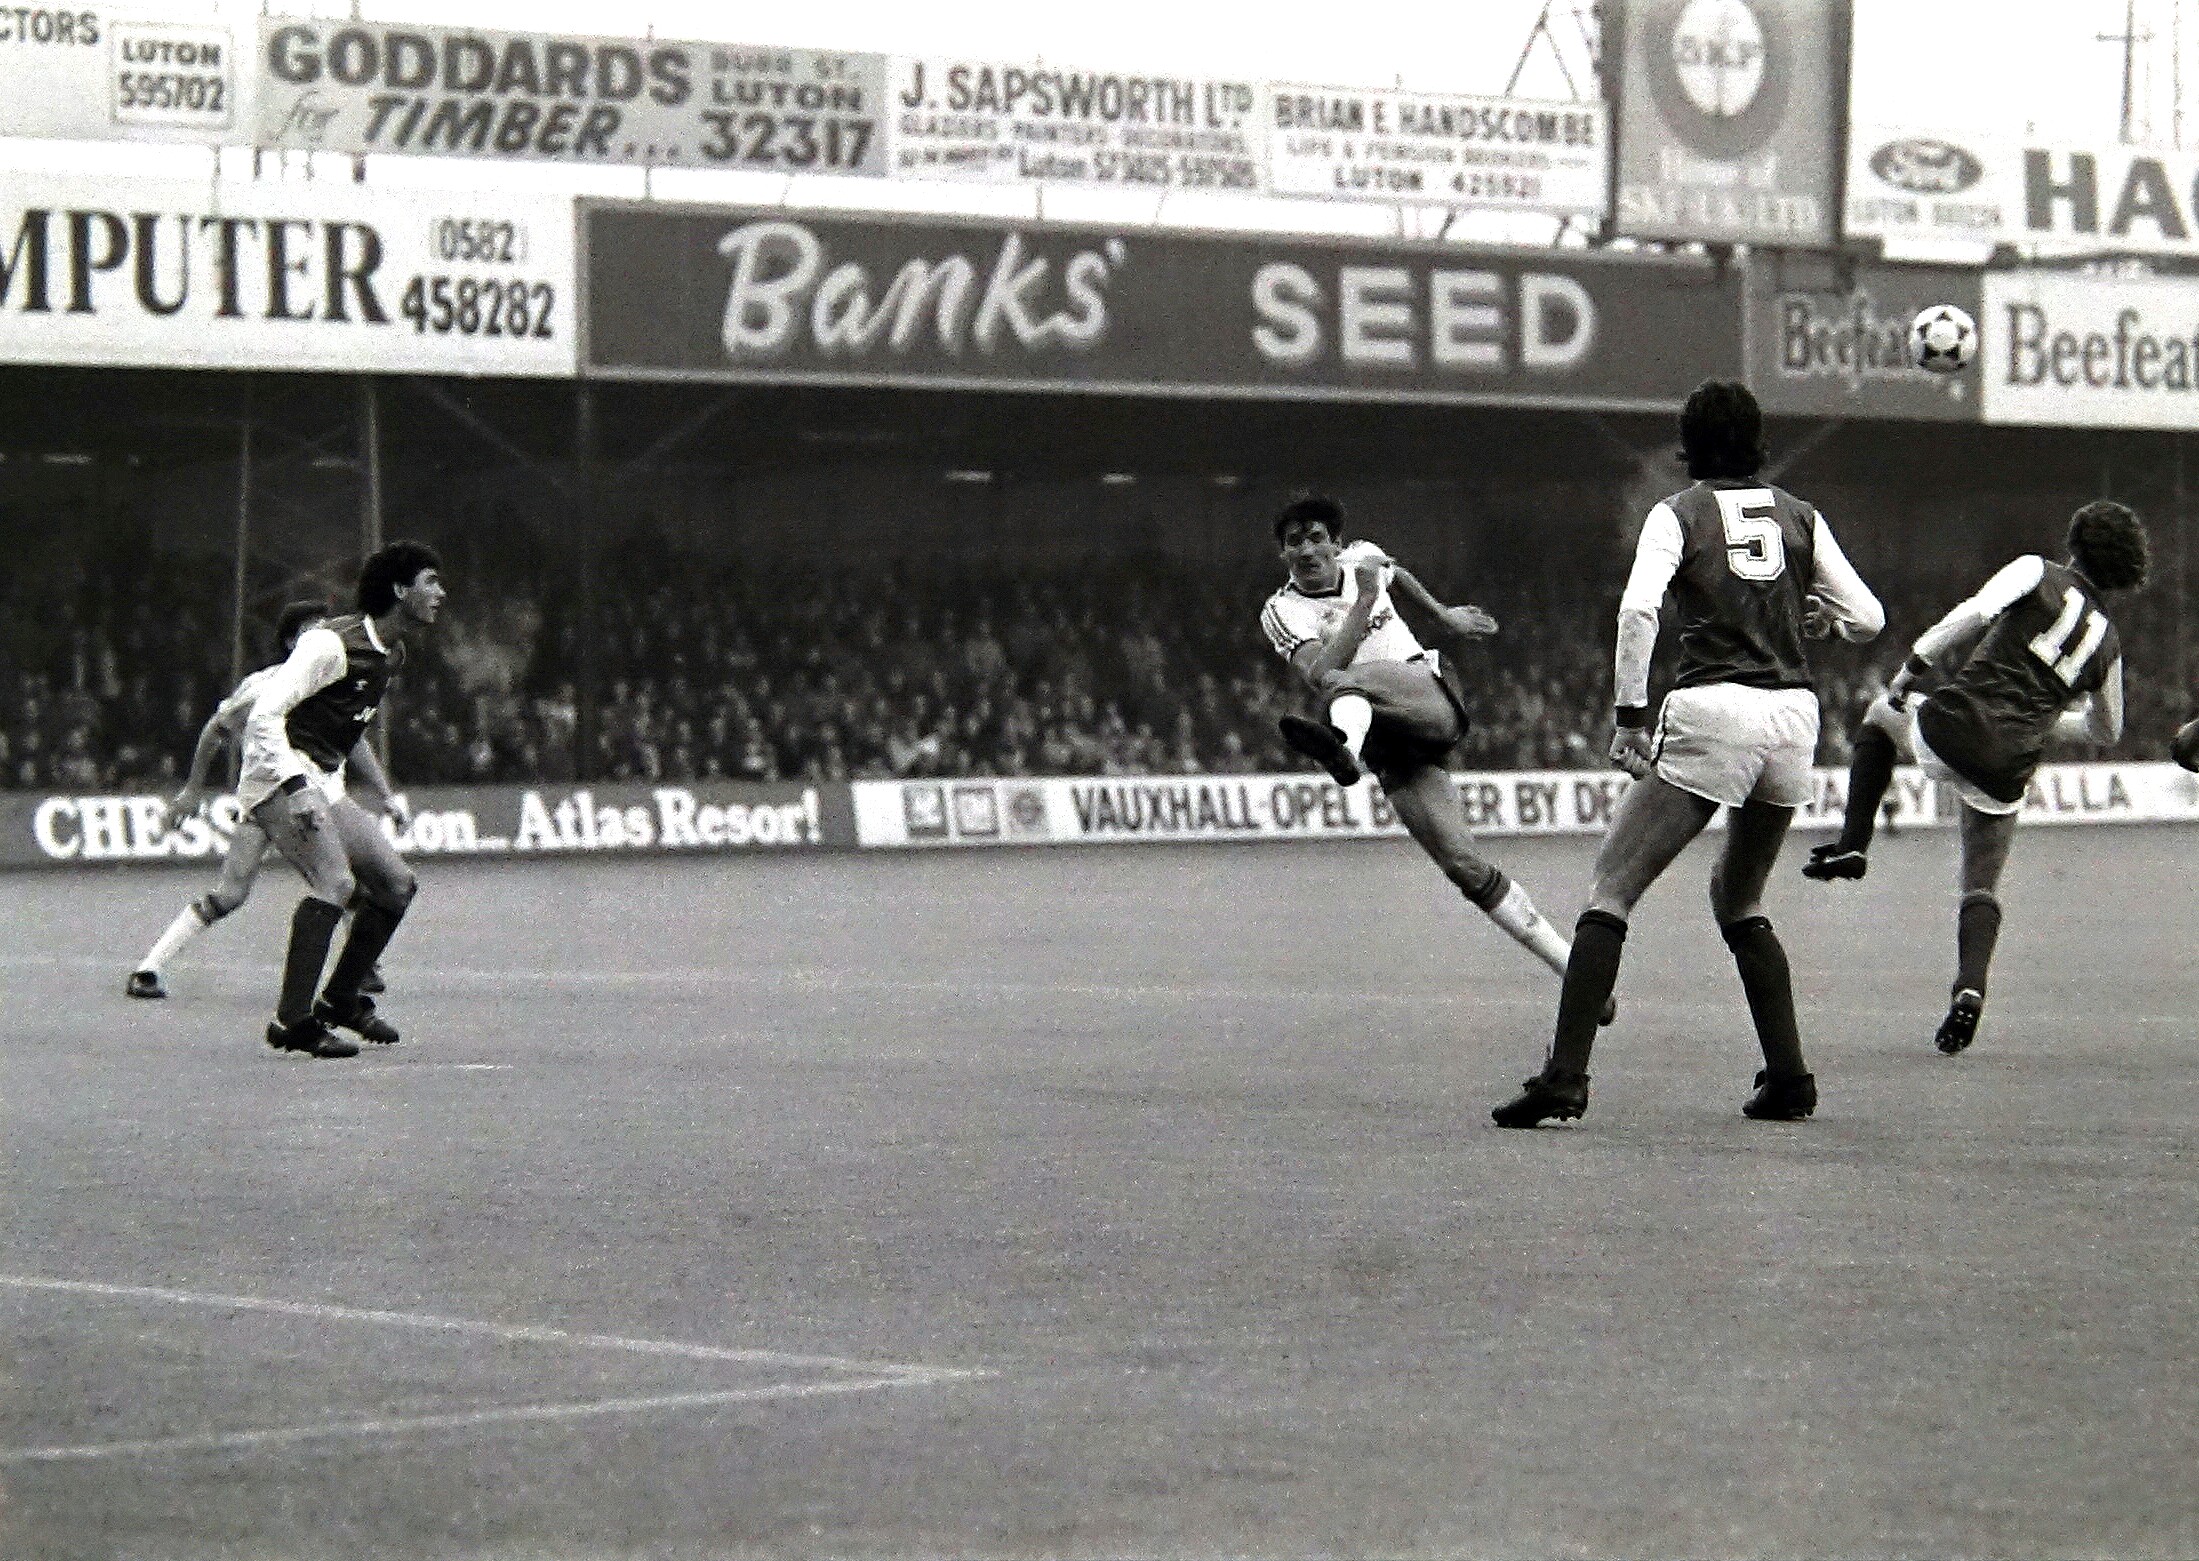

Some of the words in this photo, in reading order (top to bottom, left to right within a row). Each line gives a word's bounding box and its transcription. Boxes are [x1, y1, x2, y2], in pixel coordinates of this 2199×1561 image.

[121, 38, 221, 66] LUTON
[268, 26, 691, 103] GODDARDS
[712, 79, 862, 112] LUTON
[901, 62, 937, 109] J.
[947, 64, 1194, 123] SAPSWORTH
[1275, 93, 1364, 132] BRIAN
[701, 111, 874, 168] 32317
[2023, 146, 2199, 241] HA
[0, 208, 390, 325] MPUTER
[401, 273, 556, 339] 458282
[1252, 260, 1598, 370] SEED
[1714, 488, 1786, 582] 5
[2028, 584, 2110, 690] 11
[1515, 780, 1556, 827] BY
